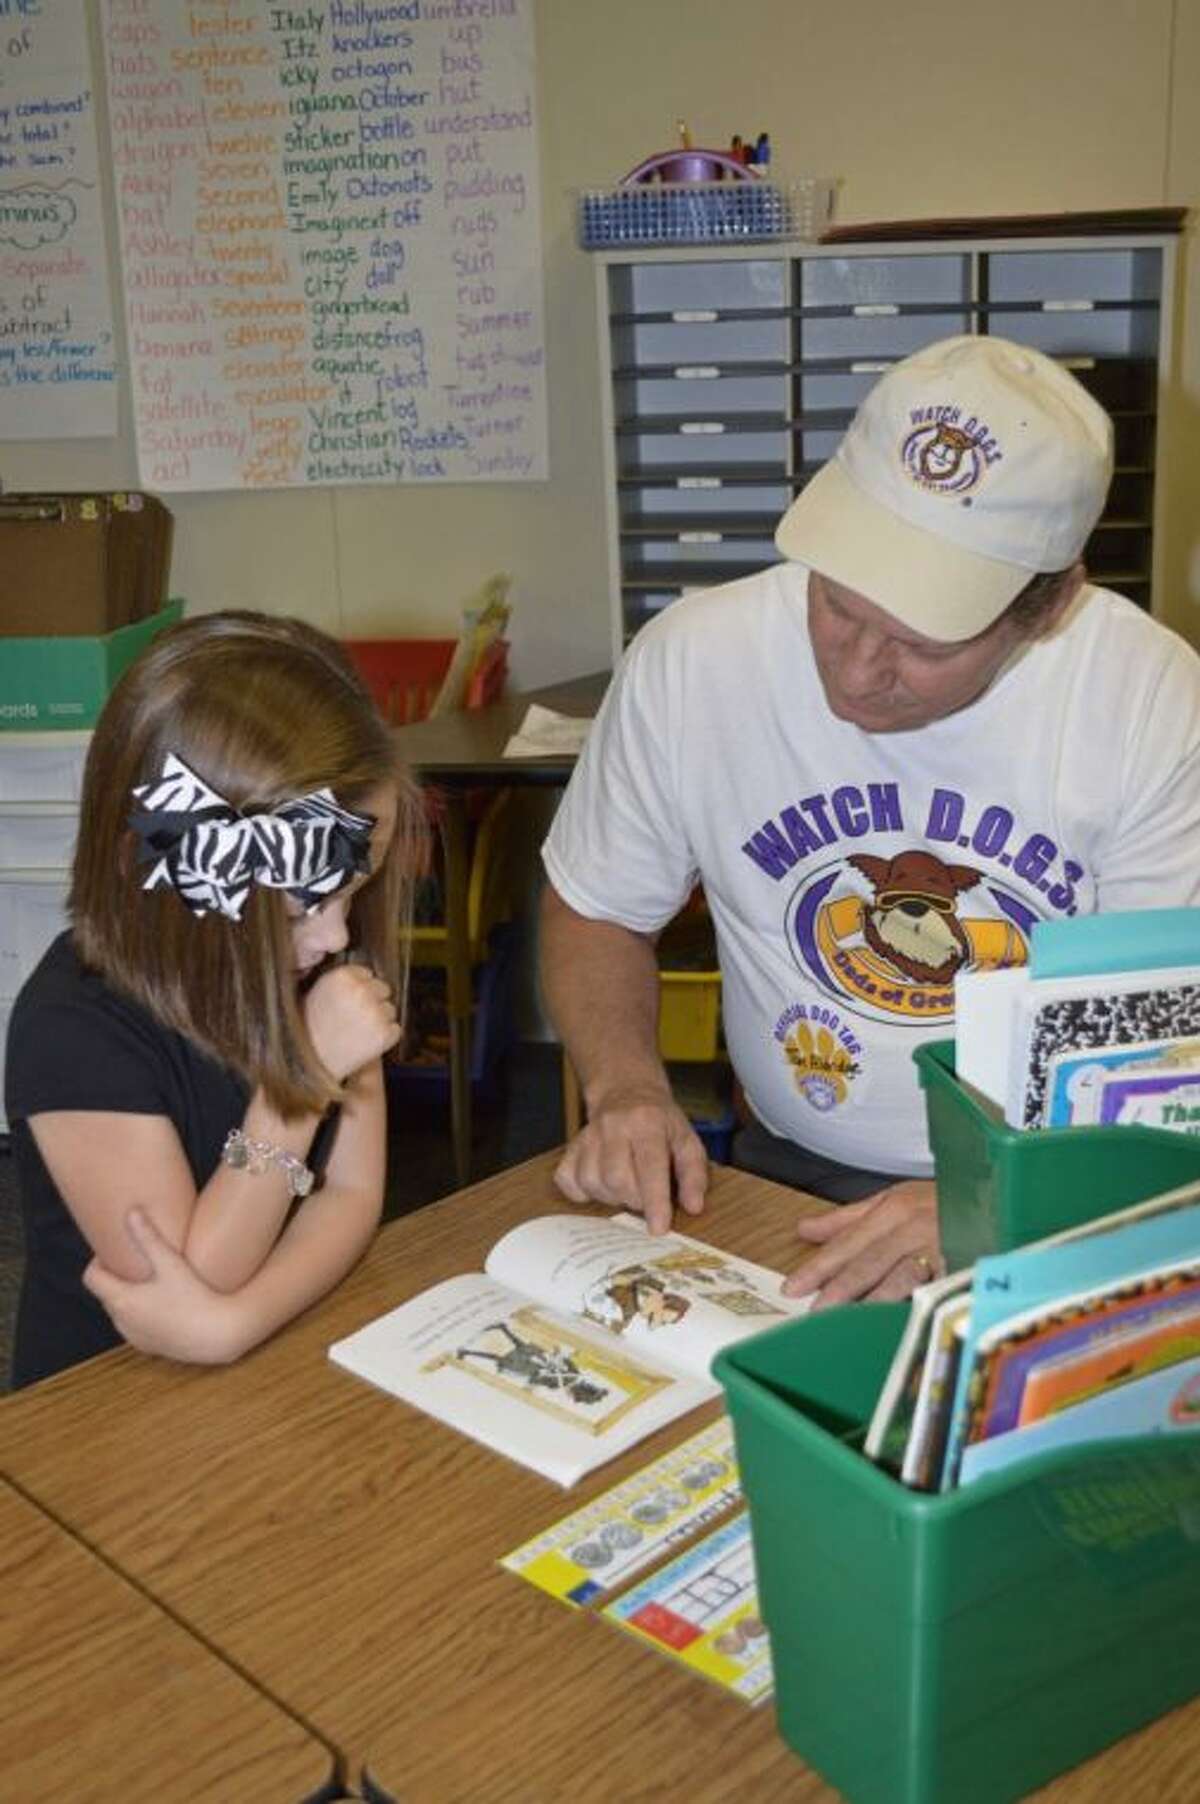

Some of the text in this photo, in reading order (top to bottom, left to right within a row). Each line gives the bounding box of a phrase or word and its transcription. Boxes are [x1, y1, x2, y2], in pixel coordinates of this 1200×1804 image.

[271, 9, 324, 34] Italy
[331, 57, 412, 85] octagon
[441, 47, 481, 74] bus
[424, 94, 532, 133] understand
[284, 145, 400, 180] imagination
[401, 147, 427, 167] on
[910, 405, 961, 424] WATCH
[308, 427, 397, 453] Christian
[0, 703, 38, 719] ards
[741, 782, 904, 882] WATCH
[834, 951, 877, 994] Dads
[881, 989, 904, 1005] of
